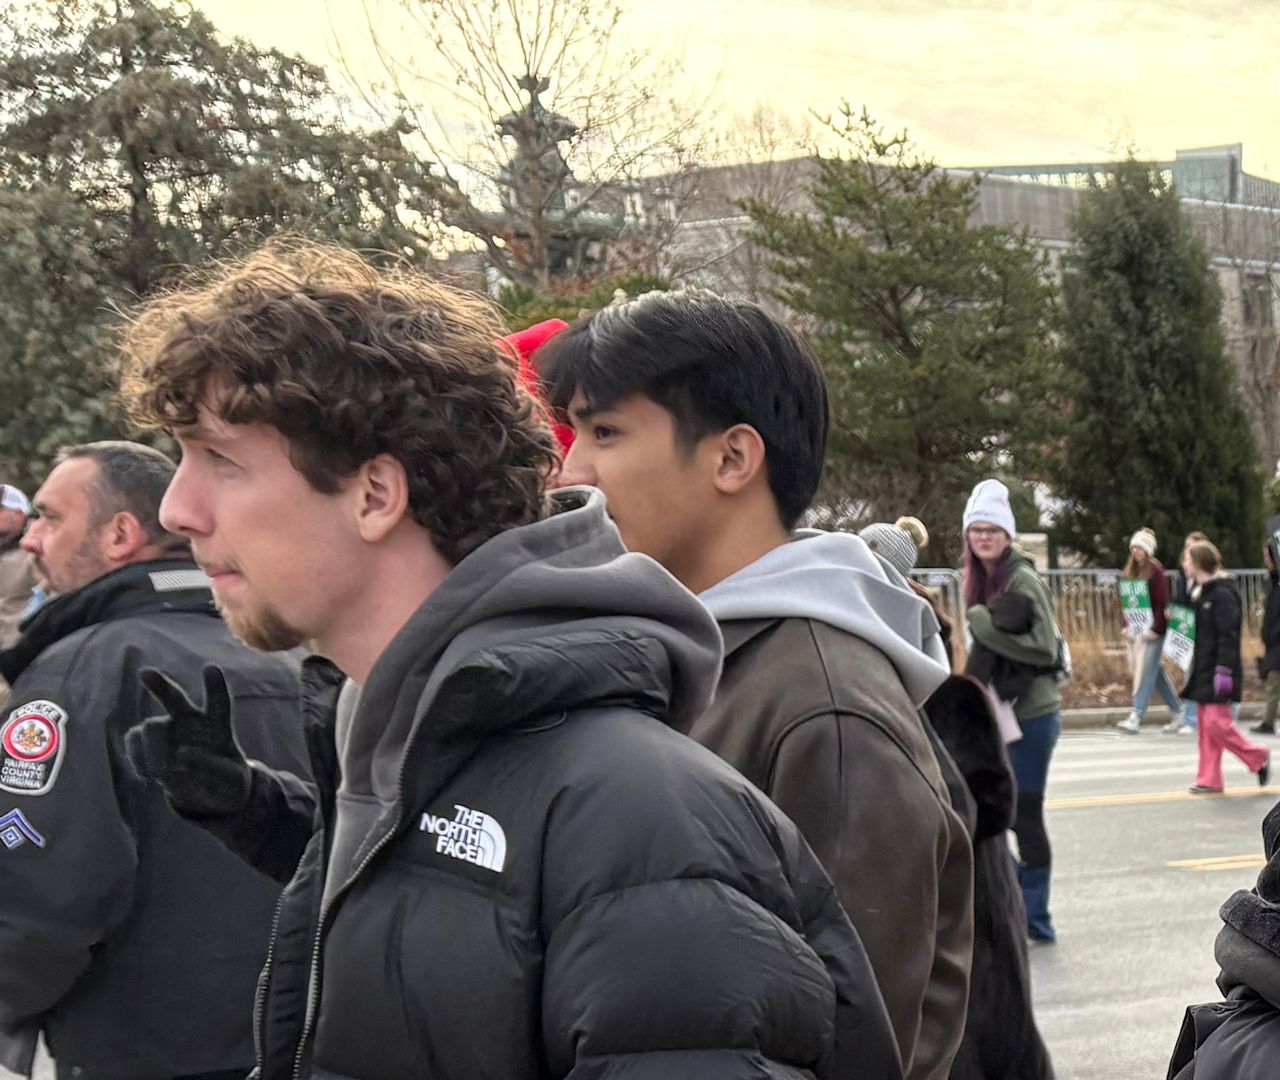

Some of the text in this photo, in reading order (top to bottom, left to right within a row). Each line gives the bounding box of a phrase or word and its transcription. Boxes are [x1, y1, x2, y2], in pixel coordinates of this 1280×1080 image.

[1, 766, 44, 780] COUNTY
[4, 757, 46, 771] FAIRFAX
[0, 775, 42, 789] VIRGINIA
[454, 804, 484, 830] THE
[419, 812, 480, 847] NORTH
[436, 835, 478, 864] FACE
